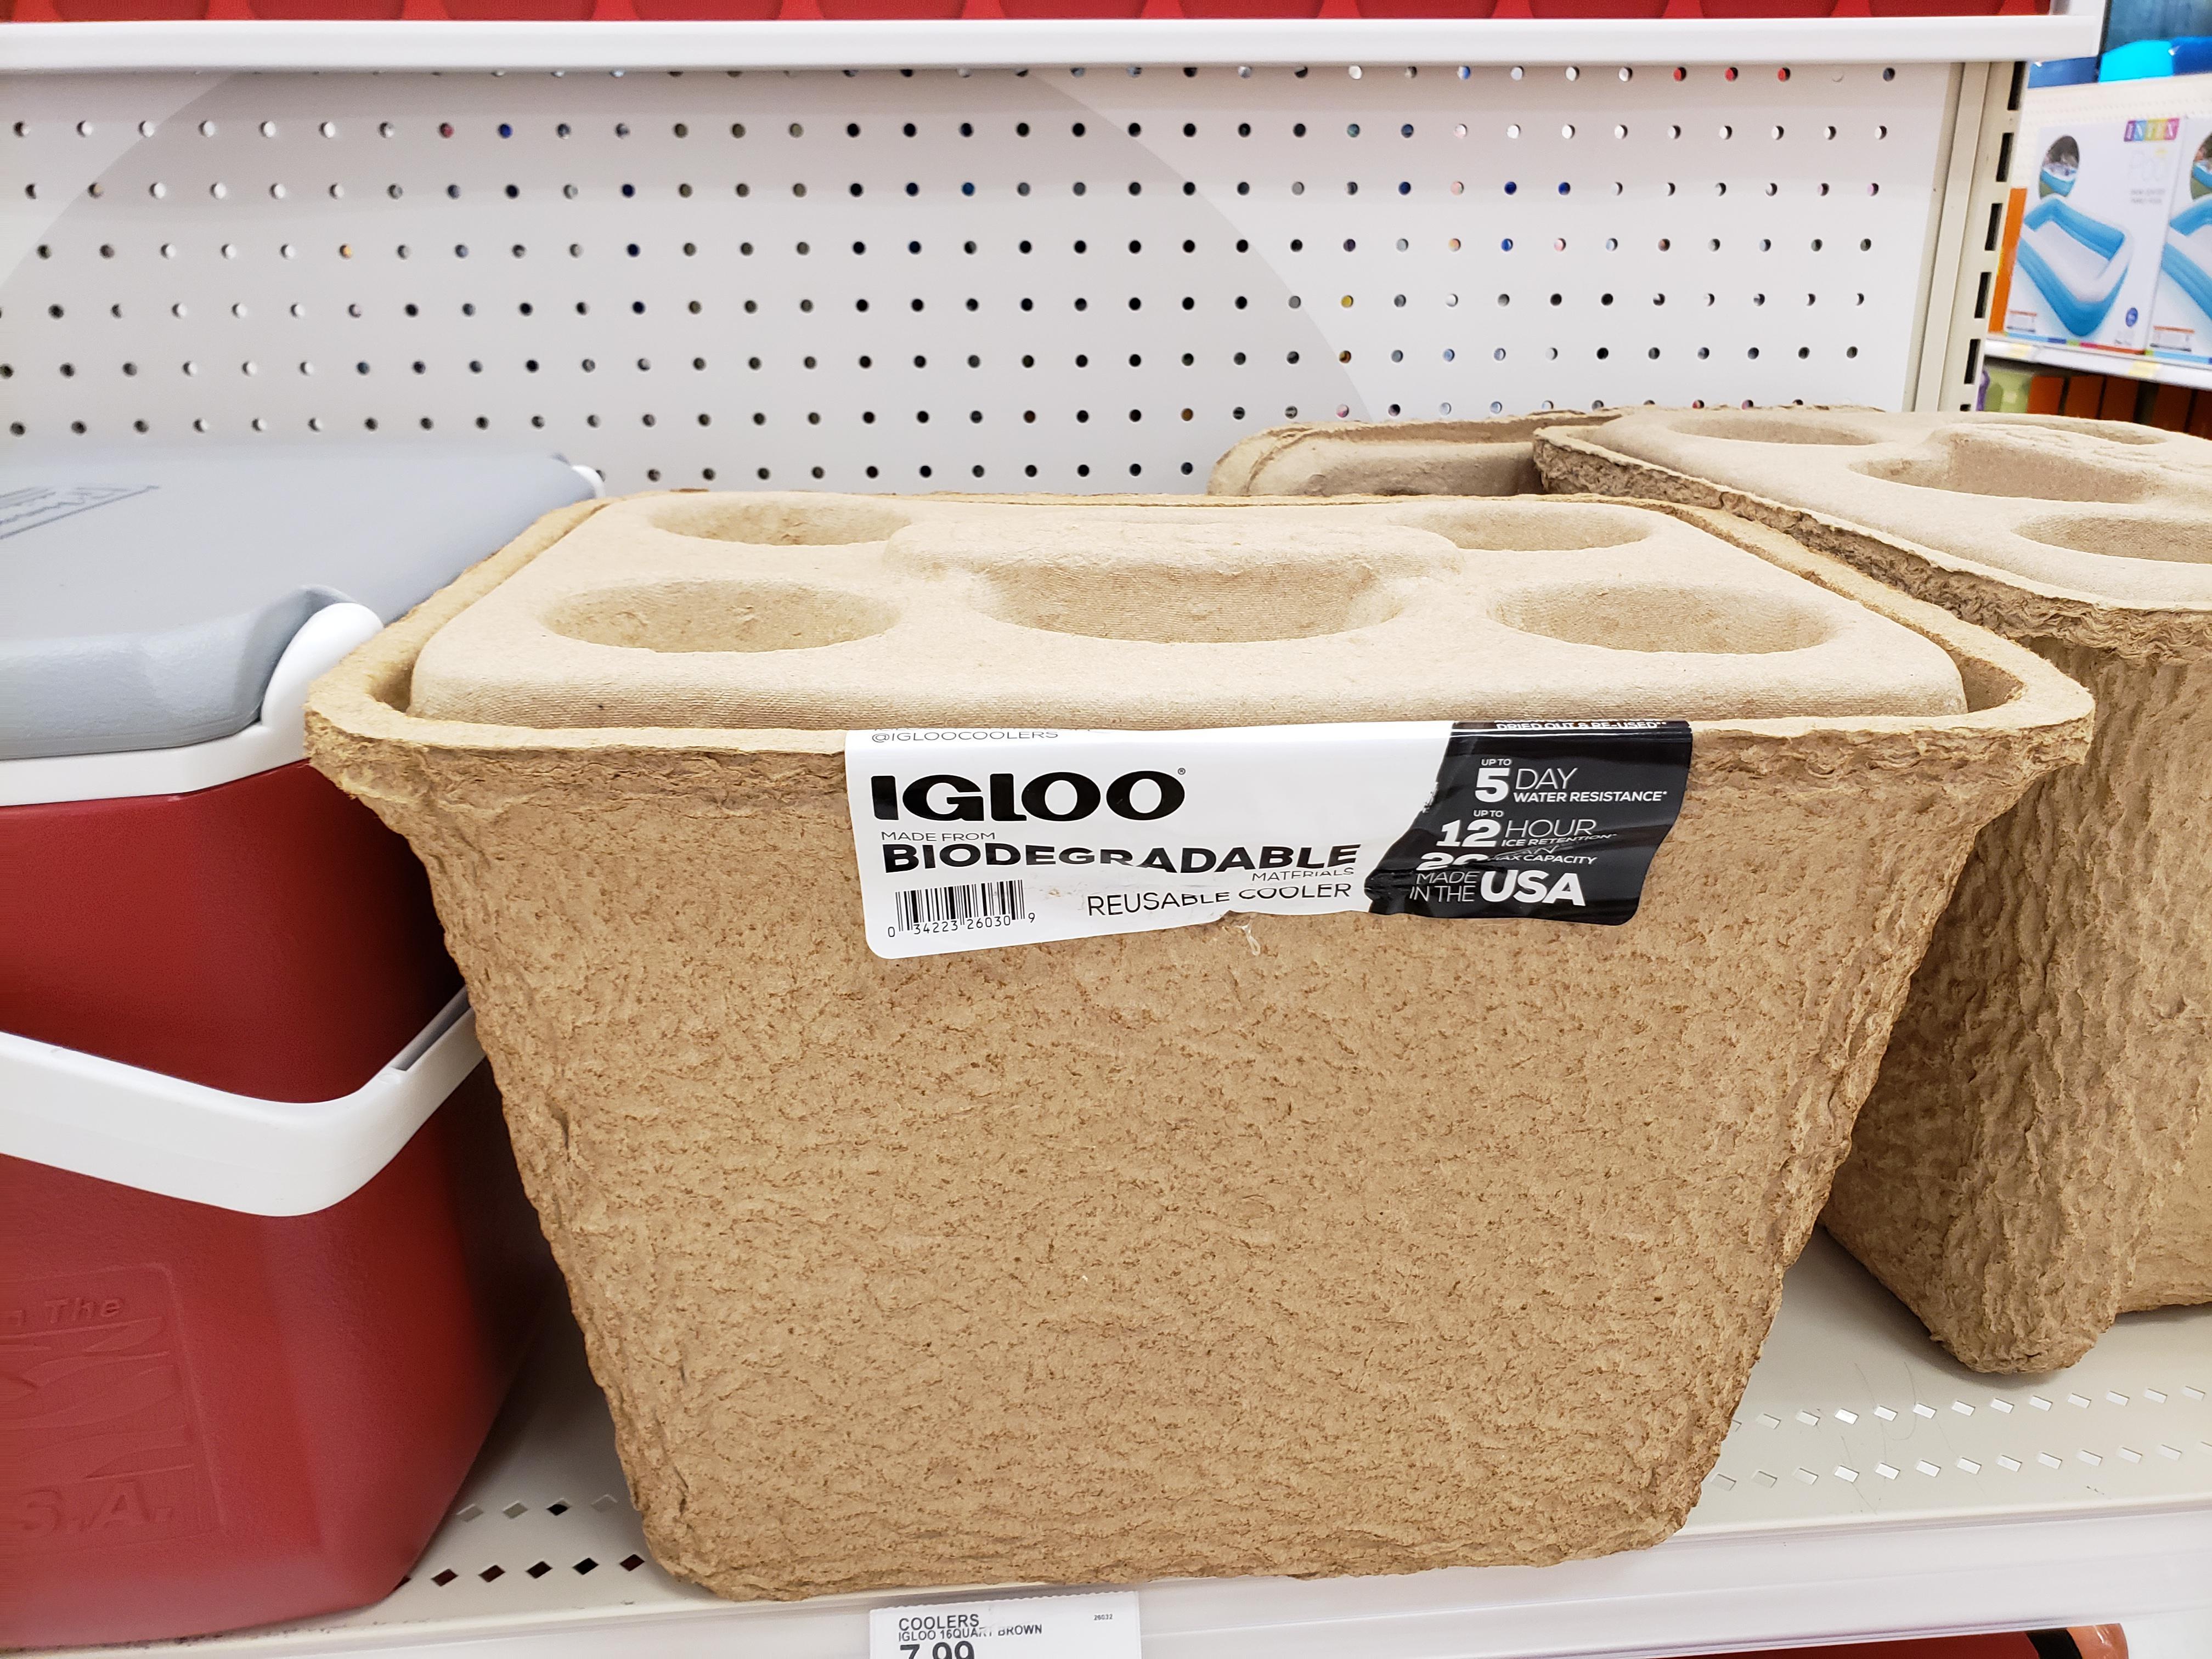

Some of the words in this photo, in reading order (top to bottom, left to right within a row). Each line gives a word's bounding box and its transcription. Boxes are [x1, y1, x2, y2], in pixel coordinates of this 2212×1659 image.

[872, 731, 1059, 743] @IGLOOCOOLERS
[1475, 768, 1509, 803] 5
[1515, 768, 1578, 790] DAY
[871, 770, 1186, 822] IGLOO
[1513, 792, 1566, 803] WATER
[881, 832, 936, 841] MADE
[942, 832, 996, 841] FROM
[1436, 819, 1501, 847] 12
[1505, 819, 1596, 838] HOUR
[1501, 839, 1526, 847] ICE
[883, 843, 1361, 873] BIODEGRADABLE
[1523, 855, 1598, 865] CAPACITY
[1252, 867, 1355, 882] MATERIALS
[1409, 885, 1428, 902] IN
[1434, 885, 1476, 902] THE
[1416, 871, 1481, 884] MADE
[1481, 870, 1586, 906] USA
[1087, 892, 1230, 916] REUSABLE
[1239, 884, 1352, 899] COOLER
[888, 926, 896, 938] 0
[913, 920, 958, 935] 34223
[967, 916, 1011, 930] 26030
[1028, 912, 1036, 923] 9
[43, 1297, 125, 1325] The
[899, 1613, 979, 1632] COOLERS
[899, 1630, 936, 1642] IGLOO
[940, 1627, 992, 1639] 16QUA
[997, 1624, 1042, 1637] BROWN
[900, 1640, 975, 1659] 799
